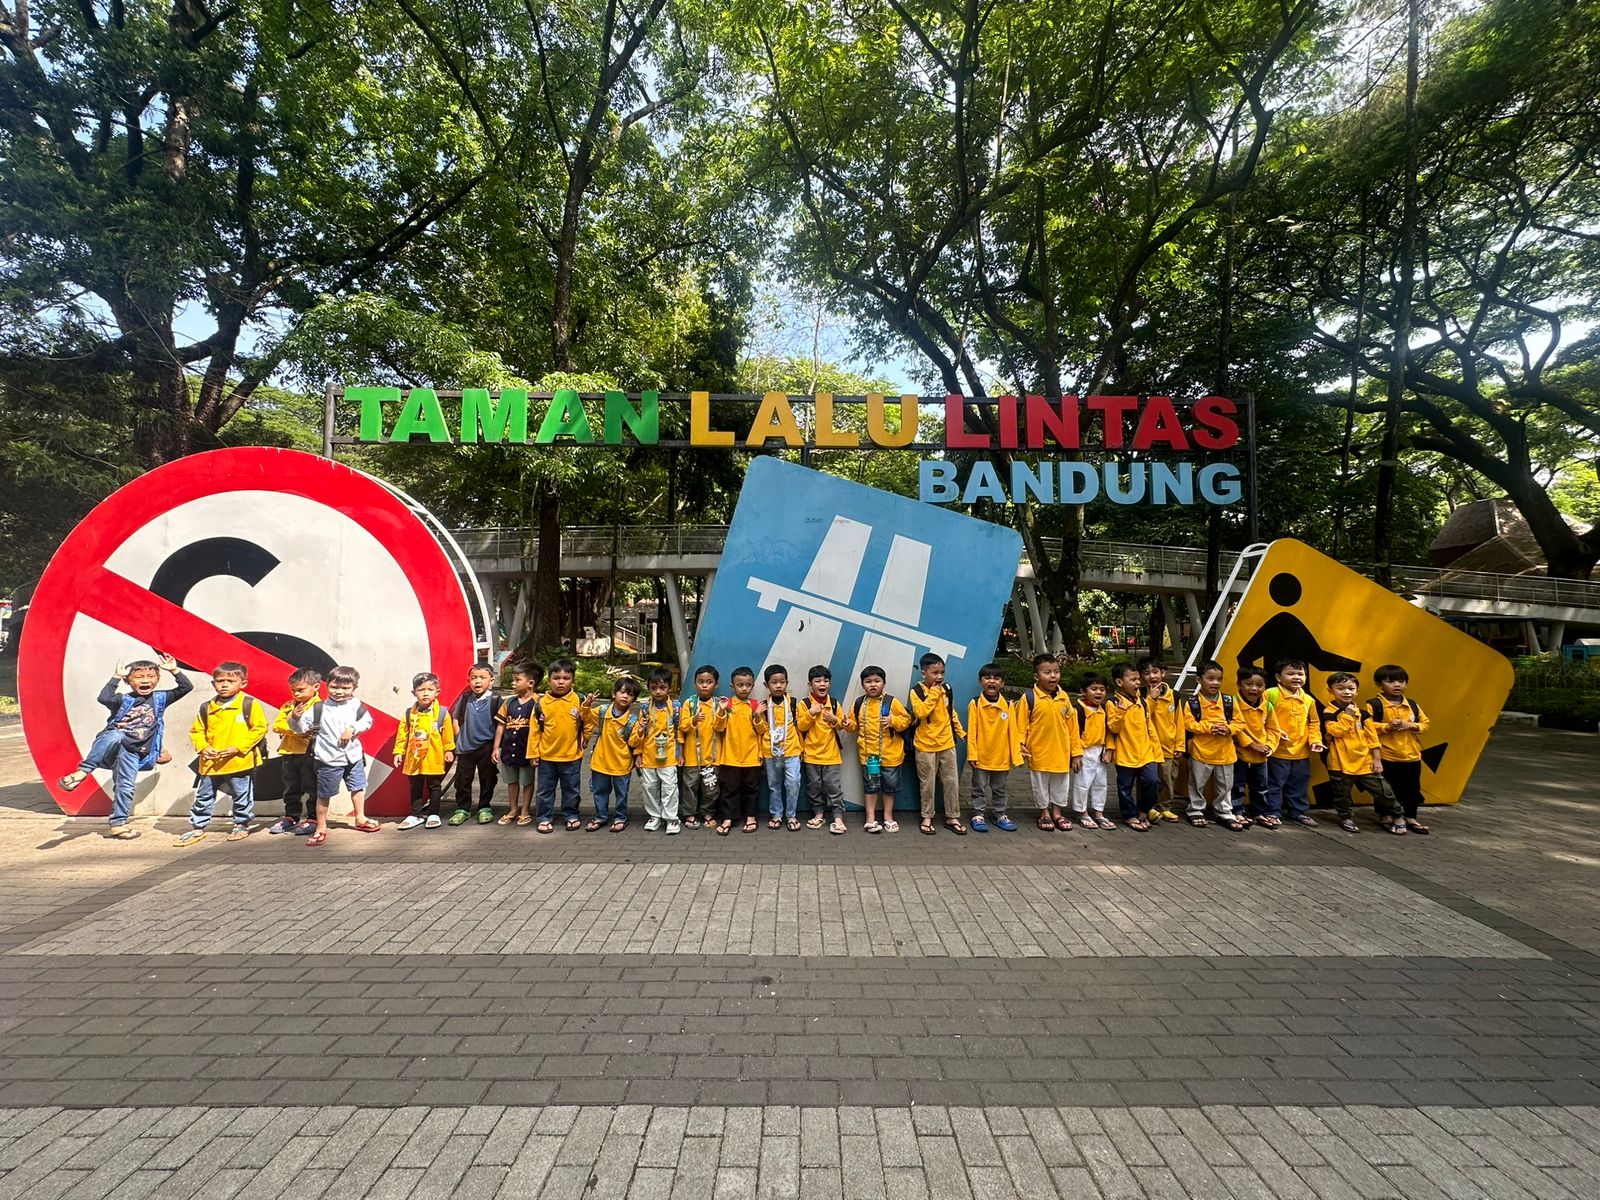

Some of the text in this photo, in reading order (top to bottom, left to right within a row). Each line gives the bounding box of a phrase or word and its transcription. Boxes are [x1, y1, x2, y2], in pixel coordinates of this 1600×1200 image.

[344, 387, 1241, 450] TAMAN LALU LINTAS
[919, 460, 1242, 506] BANDUNG
